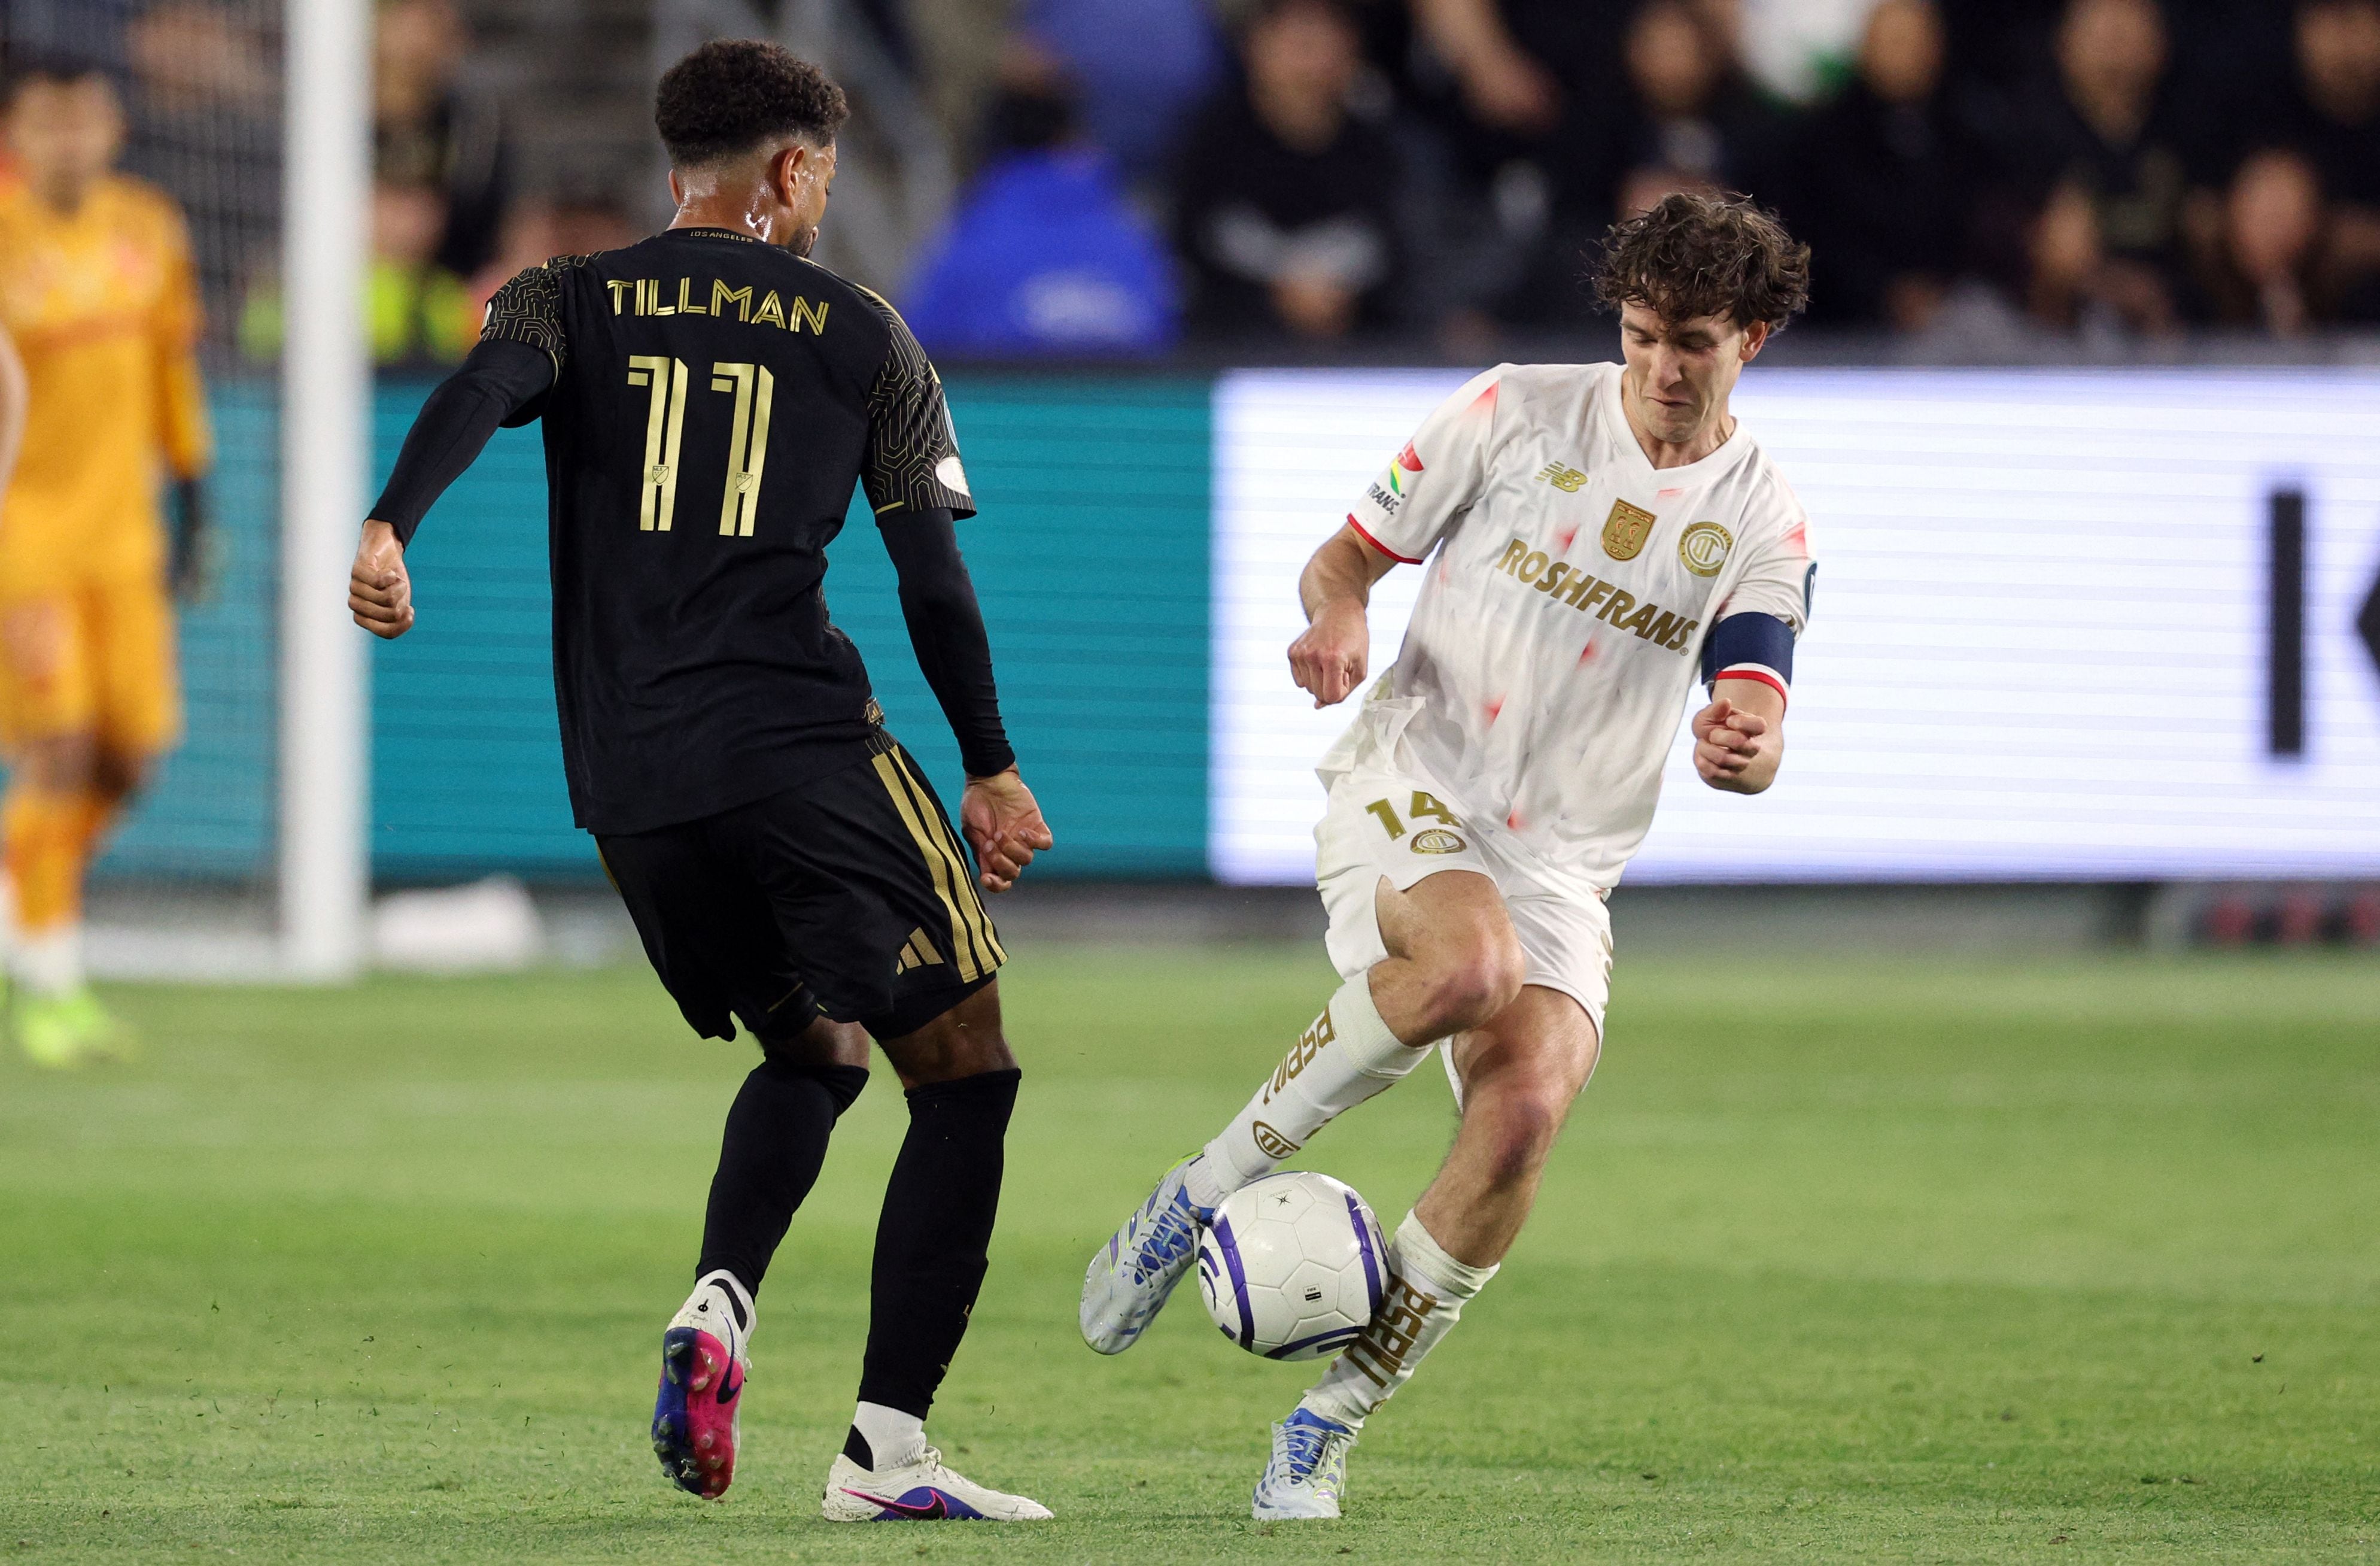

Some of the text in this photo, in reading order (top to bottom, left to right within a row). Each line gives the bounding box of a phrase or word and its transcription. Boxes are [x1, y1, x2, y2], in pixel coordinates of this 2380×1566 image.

[607, 277, 829, 336] TILLMAN
[627, 355, 774, 537] 11
[1496, 538, 1699, 651] ROSHFRANS
[1365, 791, 1463, 841] 14
